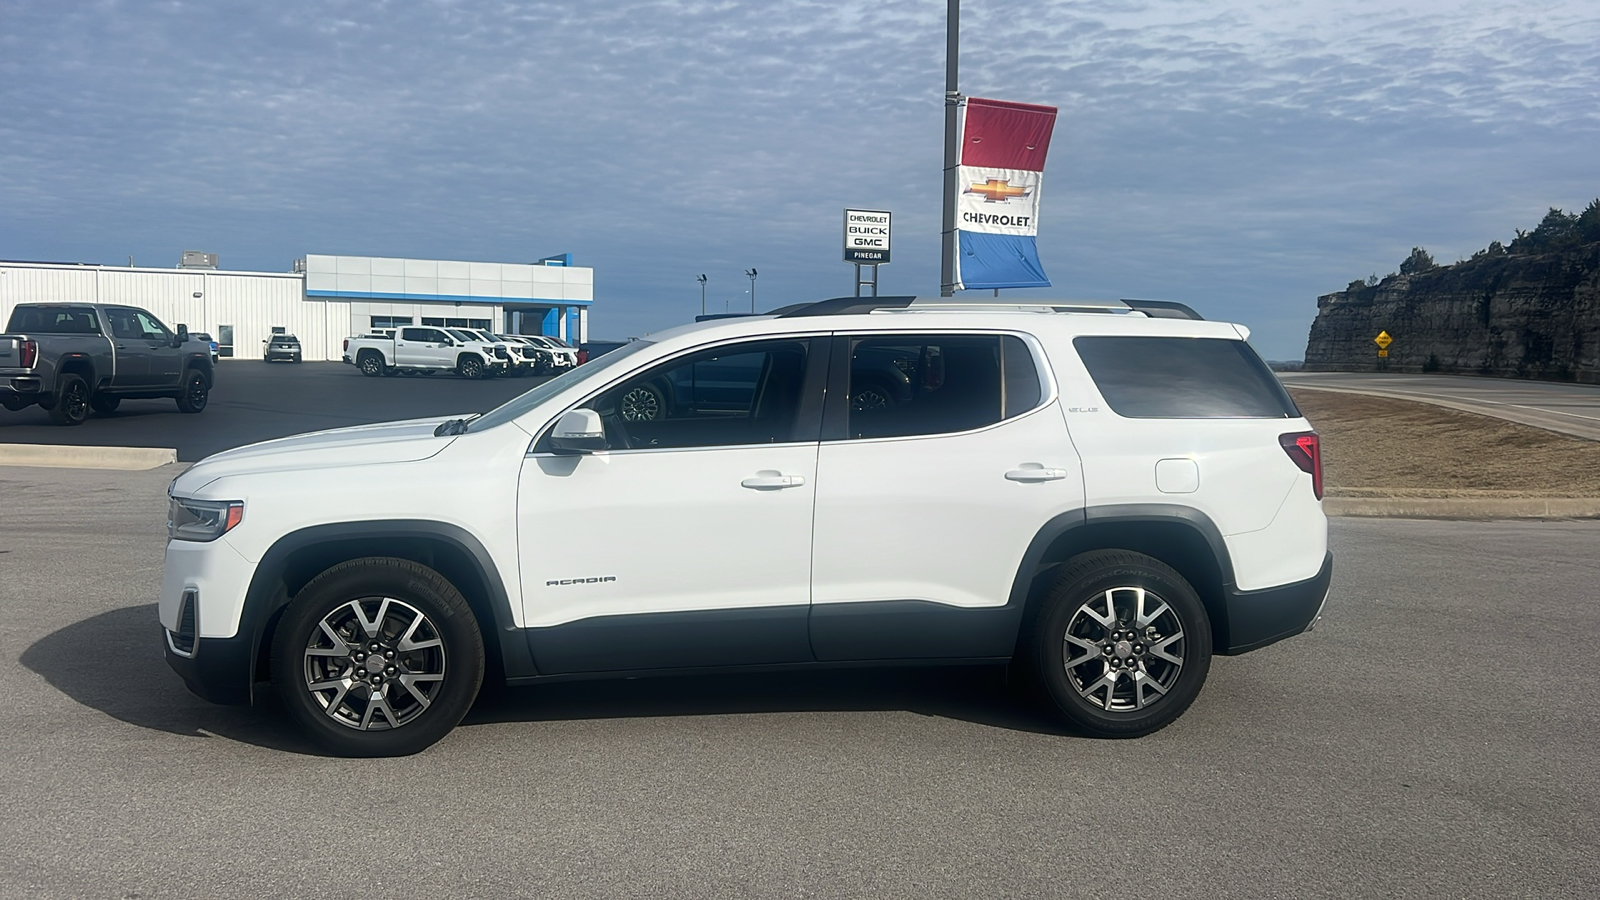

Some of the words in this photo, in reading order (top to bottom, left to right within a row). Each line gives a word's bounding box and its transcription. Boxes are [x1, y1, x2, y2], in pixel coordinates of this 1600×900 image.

[850, 215, 887, 223] CHEVROLET
[963, 212, 1030, 227] CHEVROLET
[849, 226, 887, 235] BUICK
[854, 238, 882, 246] GMC
[546, 576, 616, 586] ACADIA
